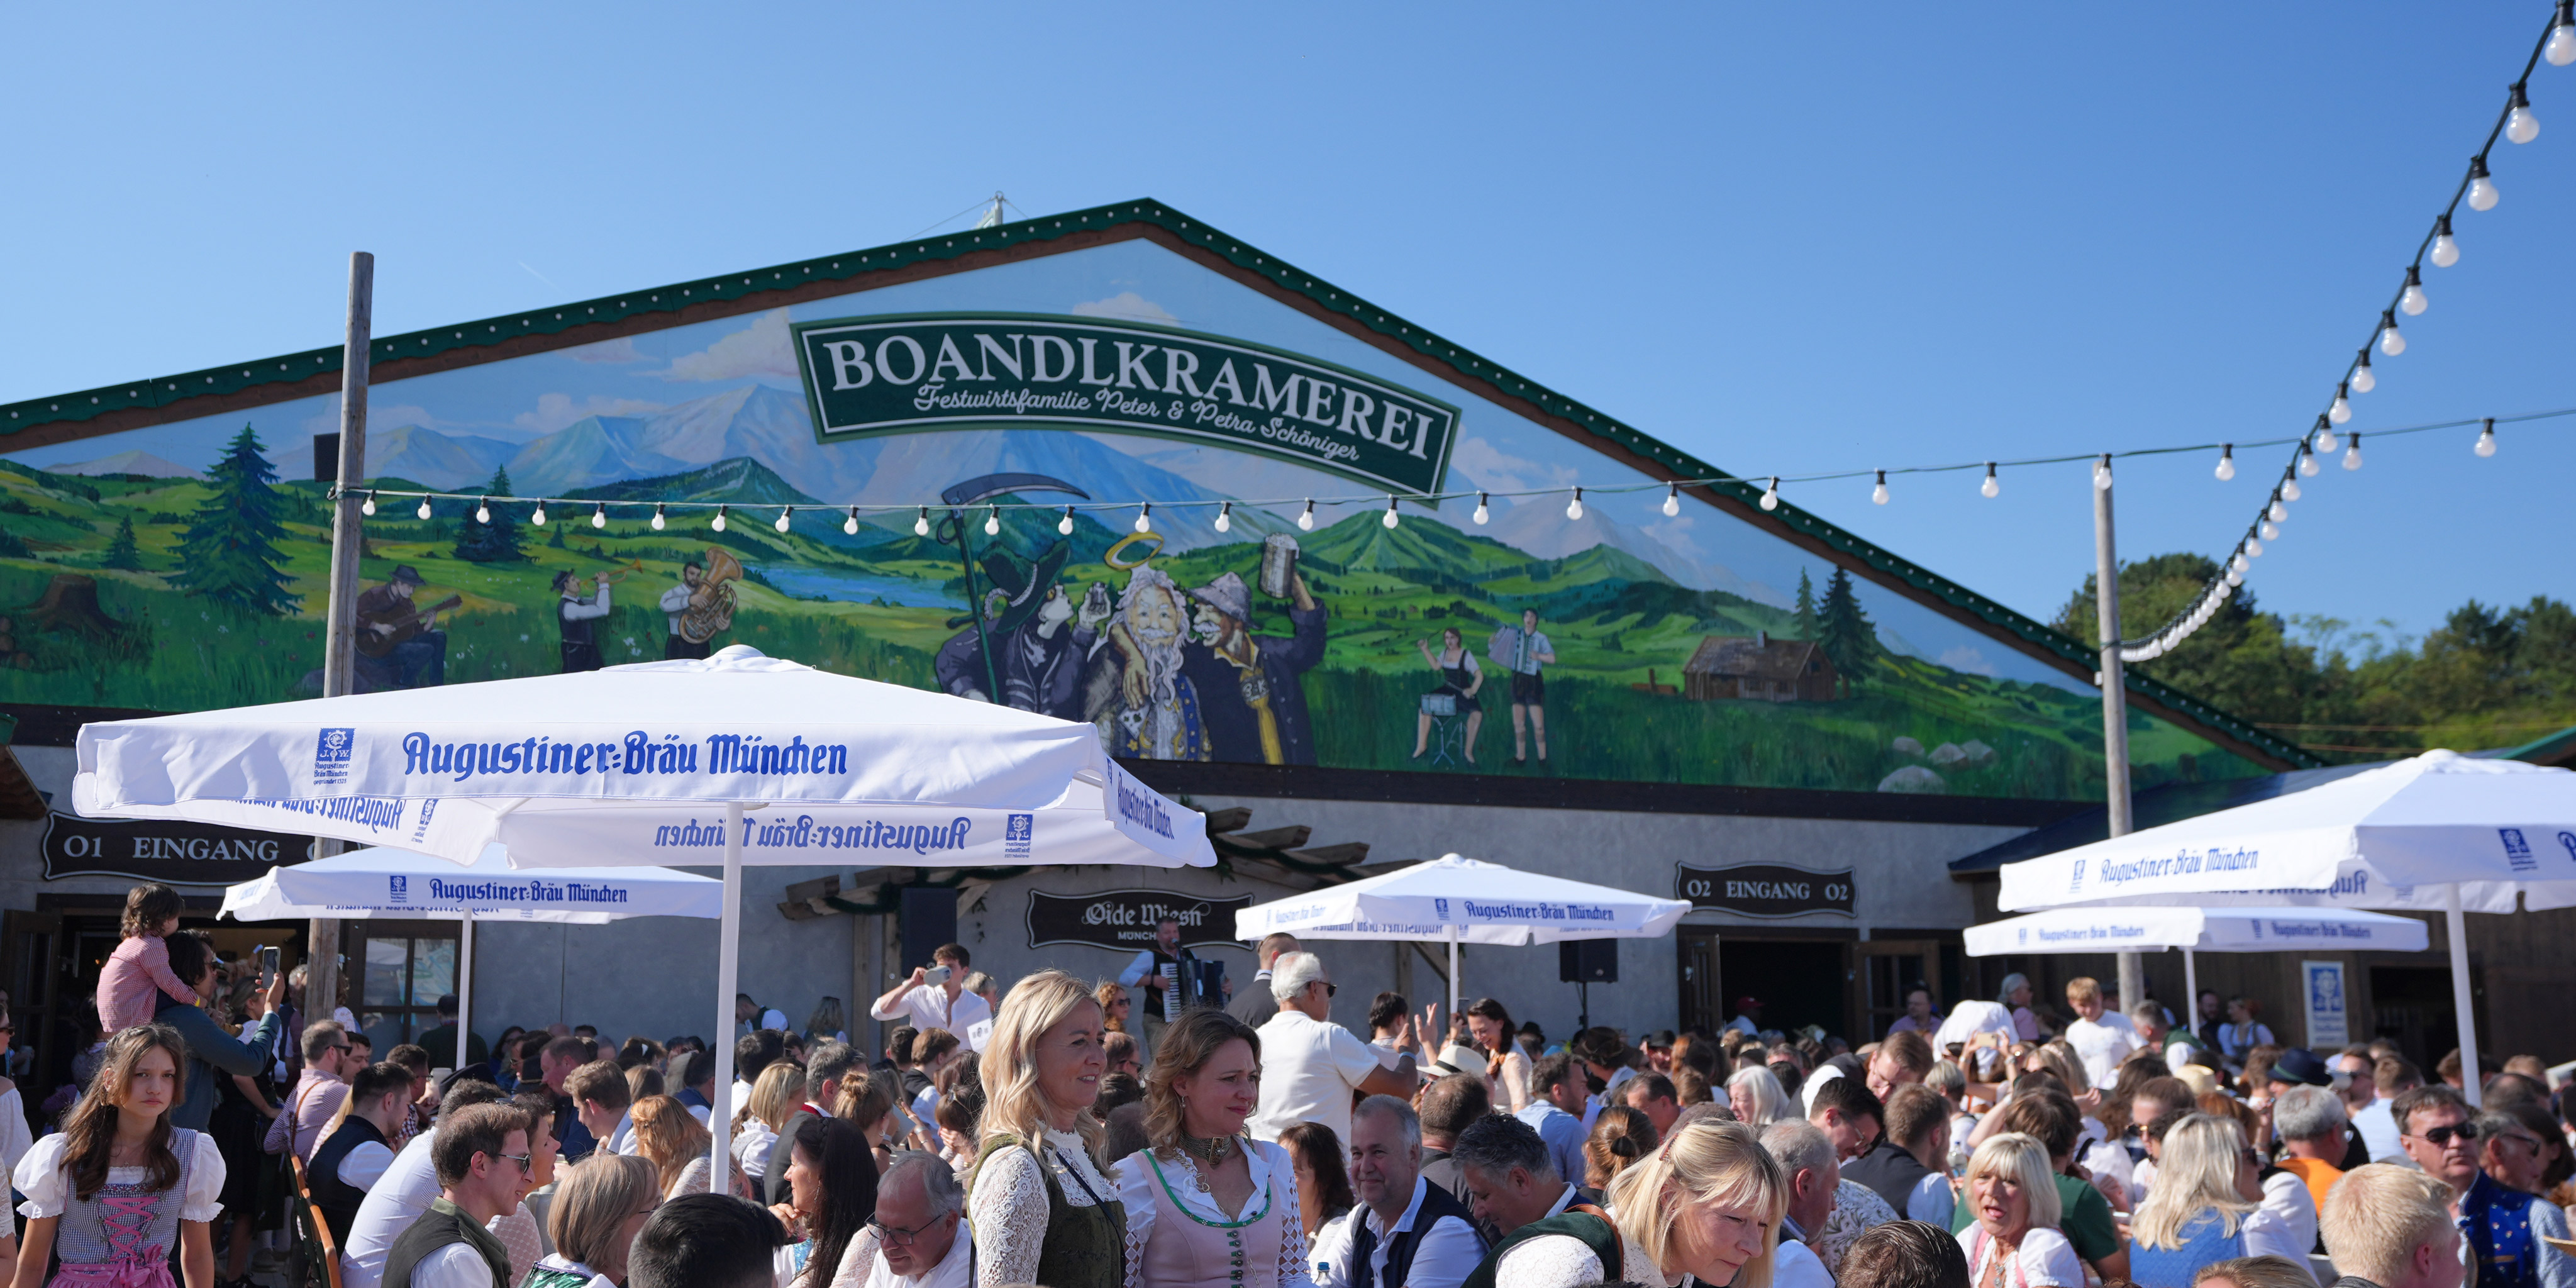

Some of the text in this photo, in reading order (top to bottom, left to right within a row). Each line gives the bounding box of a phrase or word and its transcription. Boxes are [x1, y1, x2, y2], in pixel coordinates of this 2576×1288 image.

[823, 333, 1434, 460] BOANDLKRAMEREI
[913, 384, 1360, 461] Festwirtsfamilie Peter & Petra Schöniger
[706, 734, 847, 775] München
[132, 837, 279, 861] EINGANG
[2205, 846, 2258, 872] München
[567, 883, 627, 903] München
[1726, 880, 1810, 900] EINGANG
[1567, 905, 1614, 921] München
[1118, 930, 1157, 941] MÜNCH
